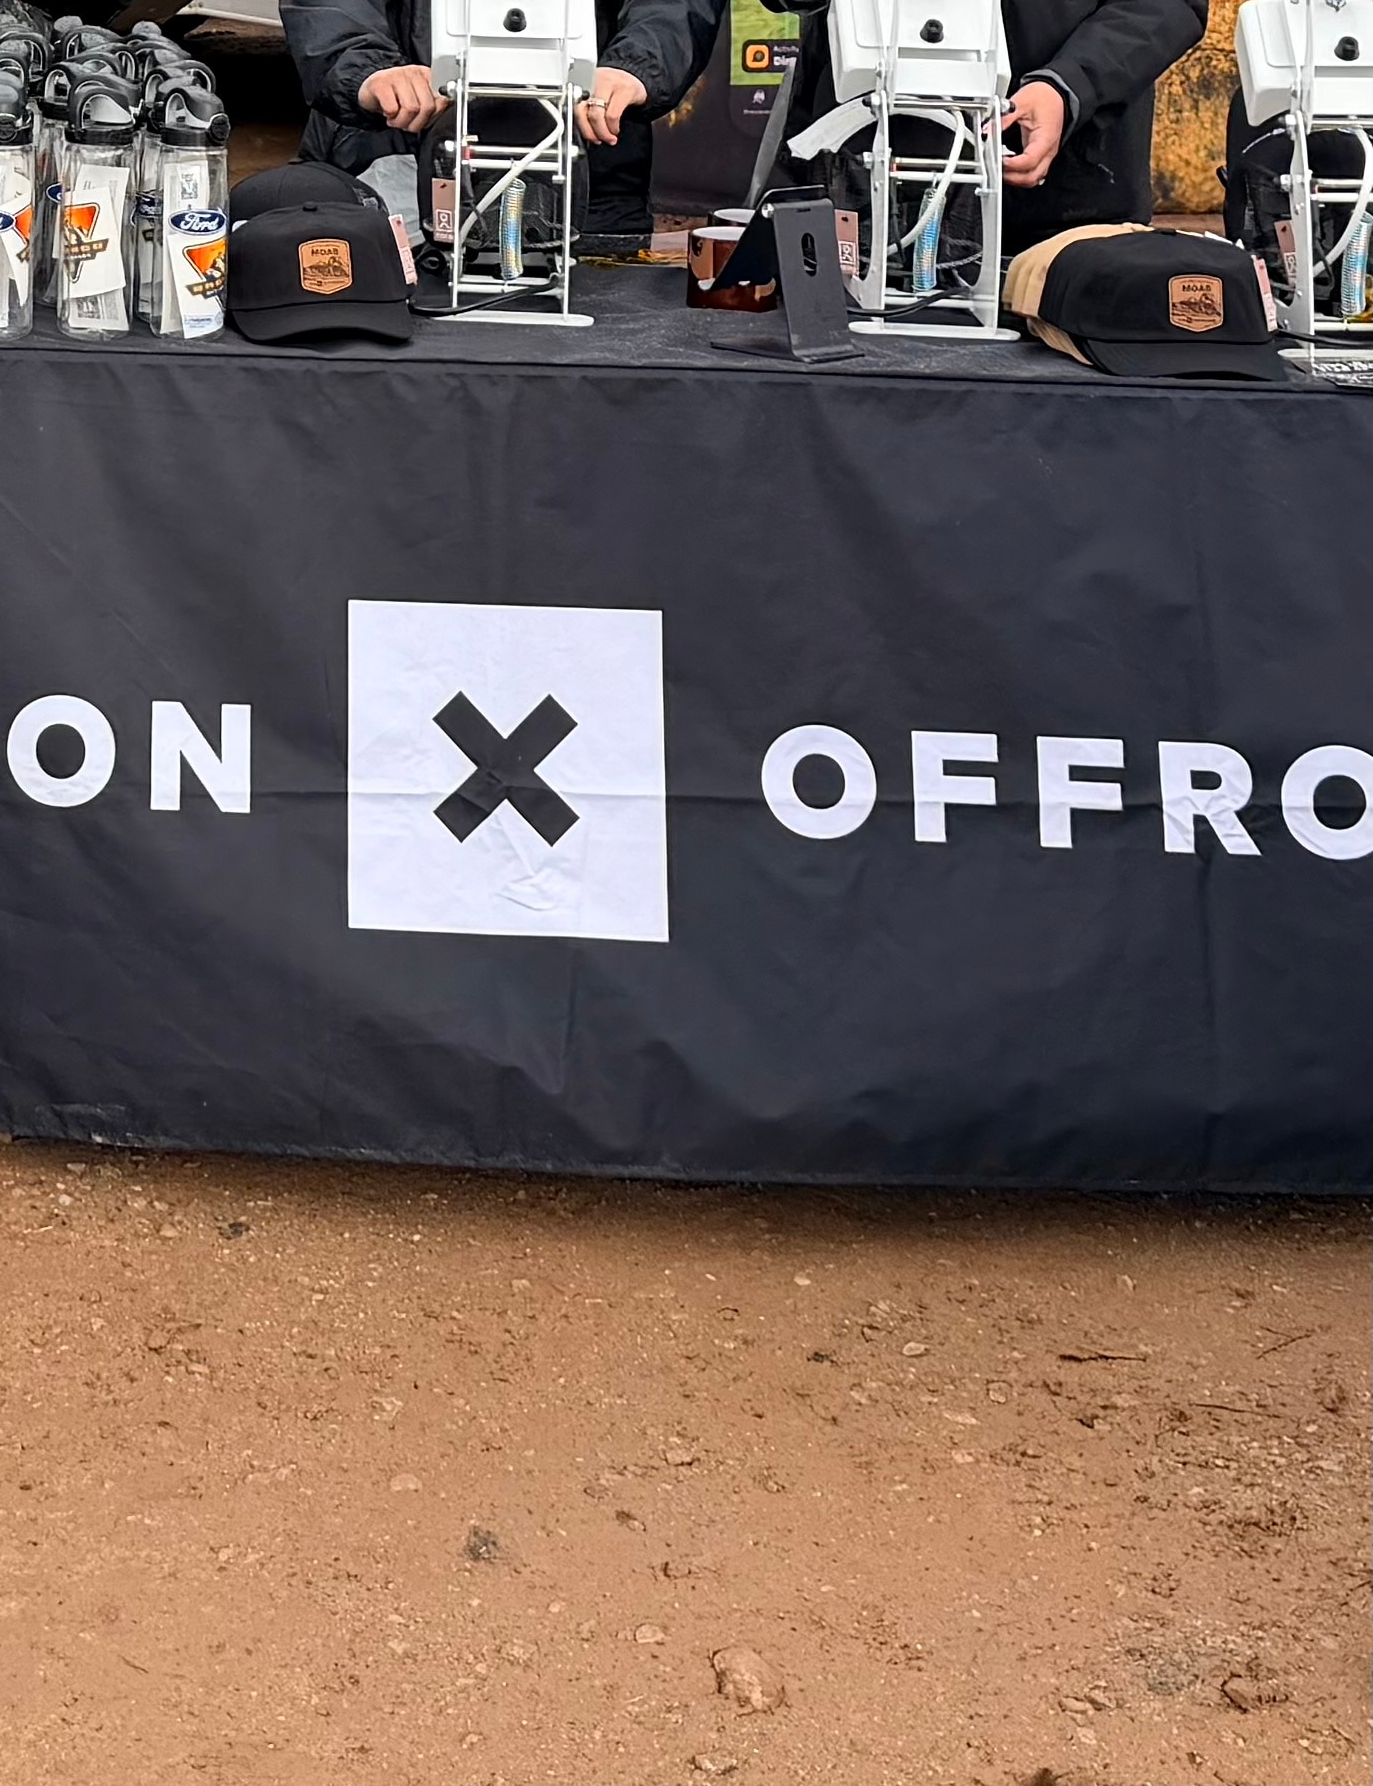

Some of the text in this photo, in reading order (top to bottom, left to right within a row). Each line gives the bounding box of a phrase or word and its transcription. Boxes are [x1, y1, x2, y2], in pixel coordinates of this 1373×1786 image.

[180, 214, 219, 230] Ford
[7, 694, 252, 813] ON
[761, 723, 1373, 862] OFFRO
